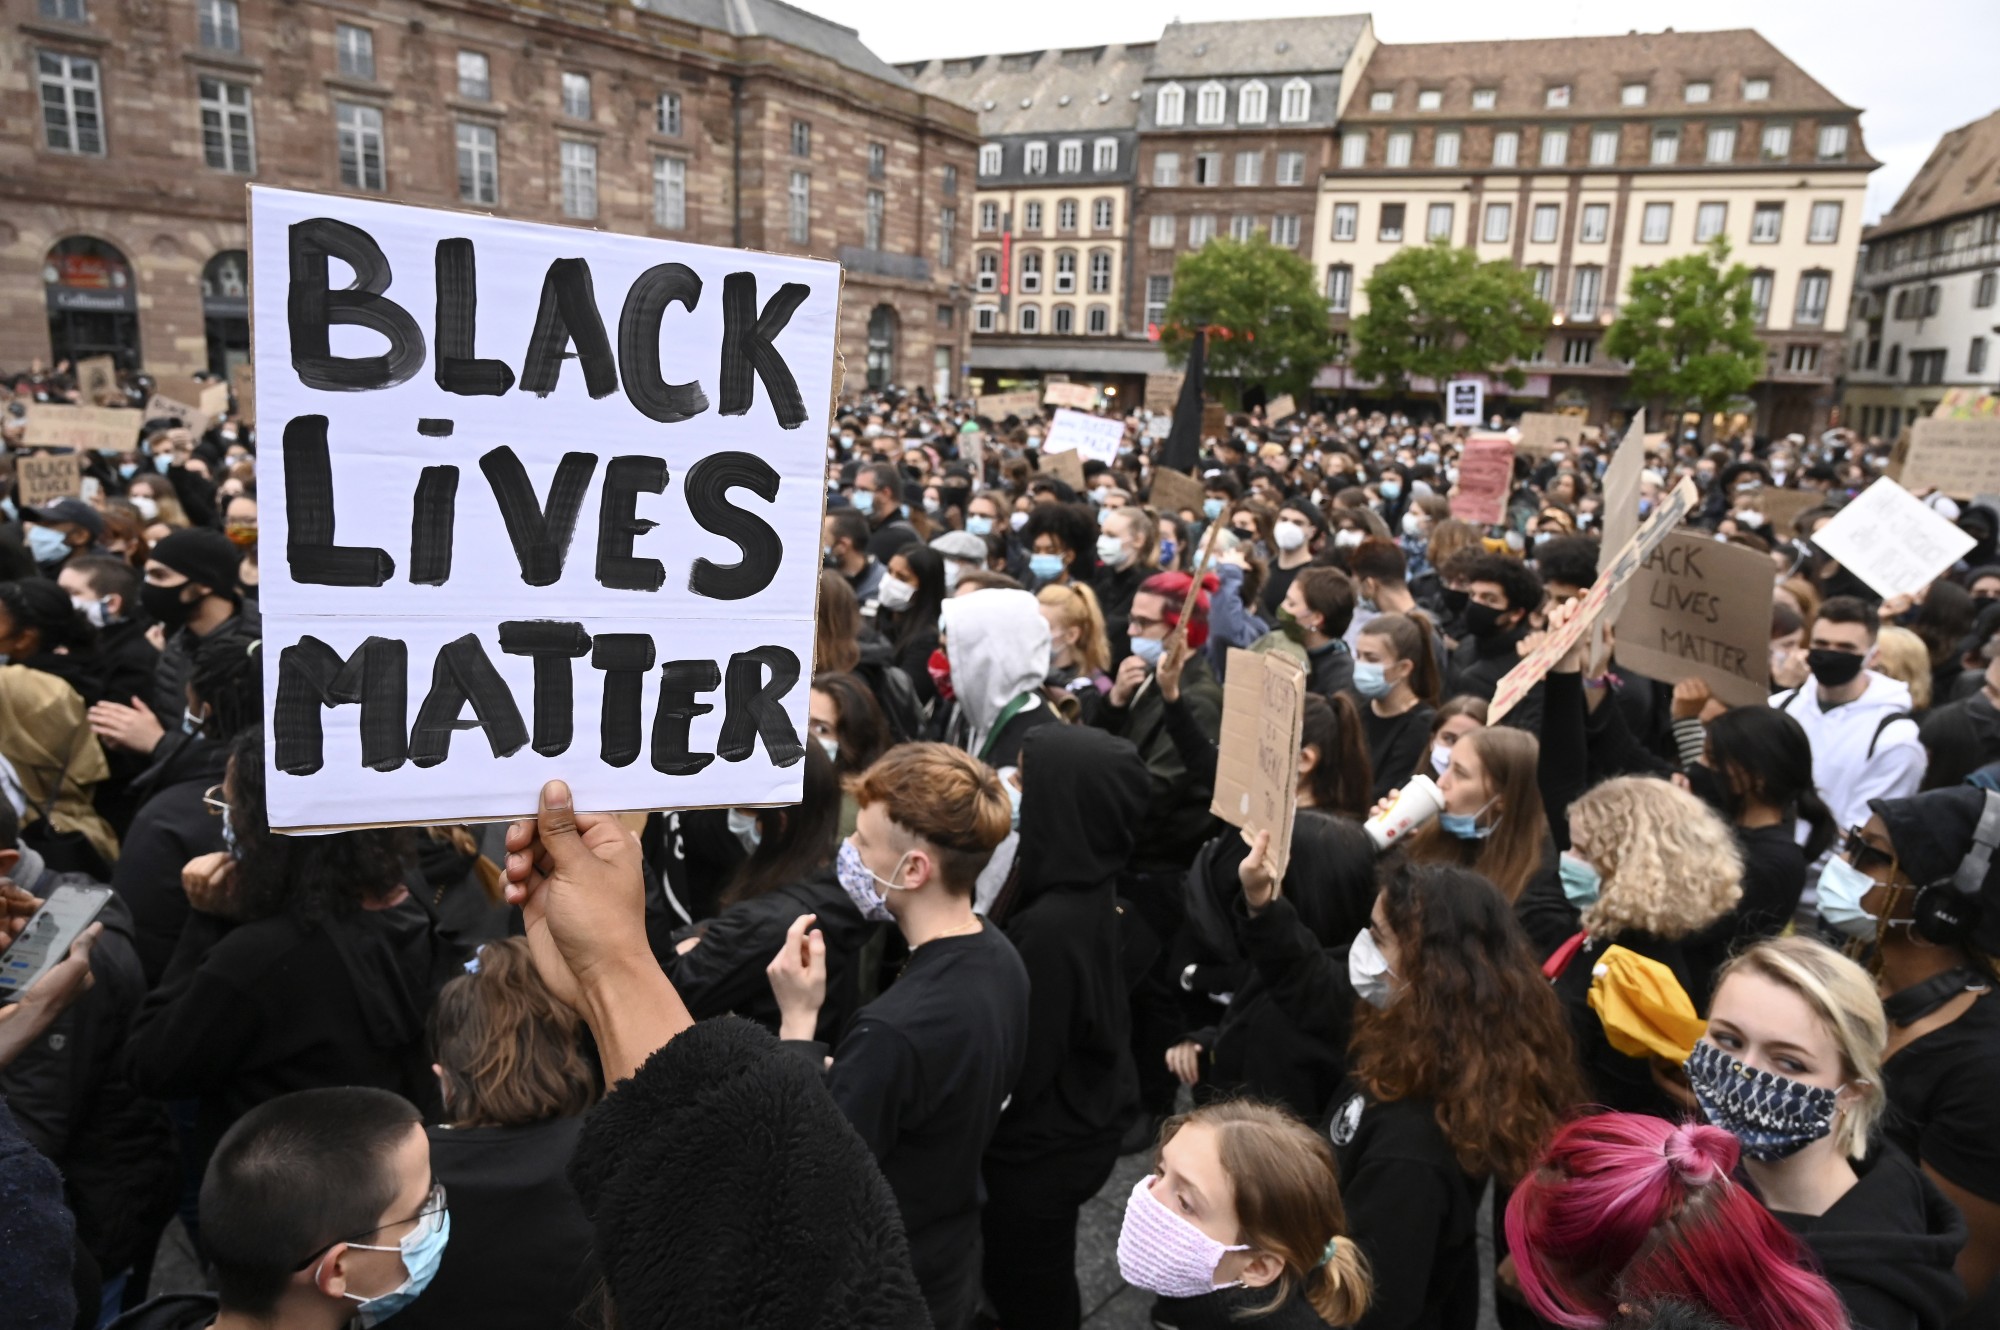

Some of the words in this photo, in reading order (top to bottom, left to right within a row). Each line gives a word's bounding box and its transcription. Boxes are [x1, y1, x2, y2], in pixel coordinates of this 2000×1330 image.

[288, 217, 811, 429] BLACK
[1642, 543, 1703, 579] ACK
[1651, 579, 1720, 623] LIVES
[1661, 627, 1750, 680] MATTER
[273, 619, 806, 776] MATTER
